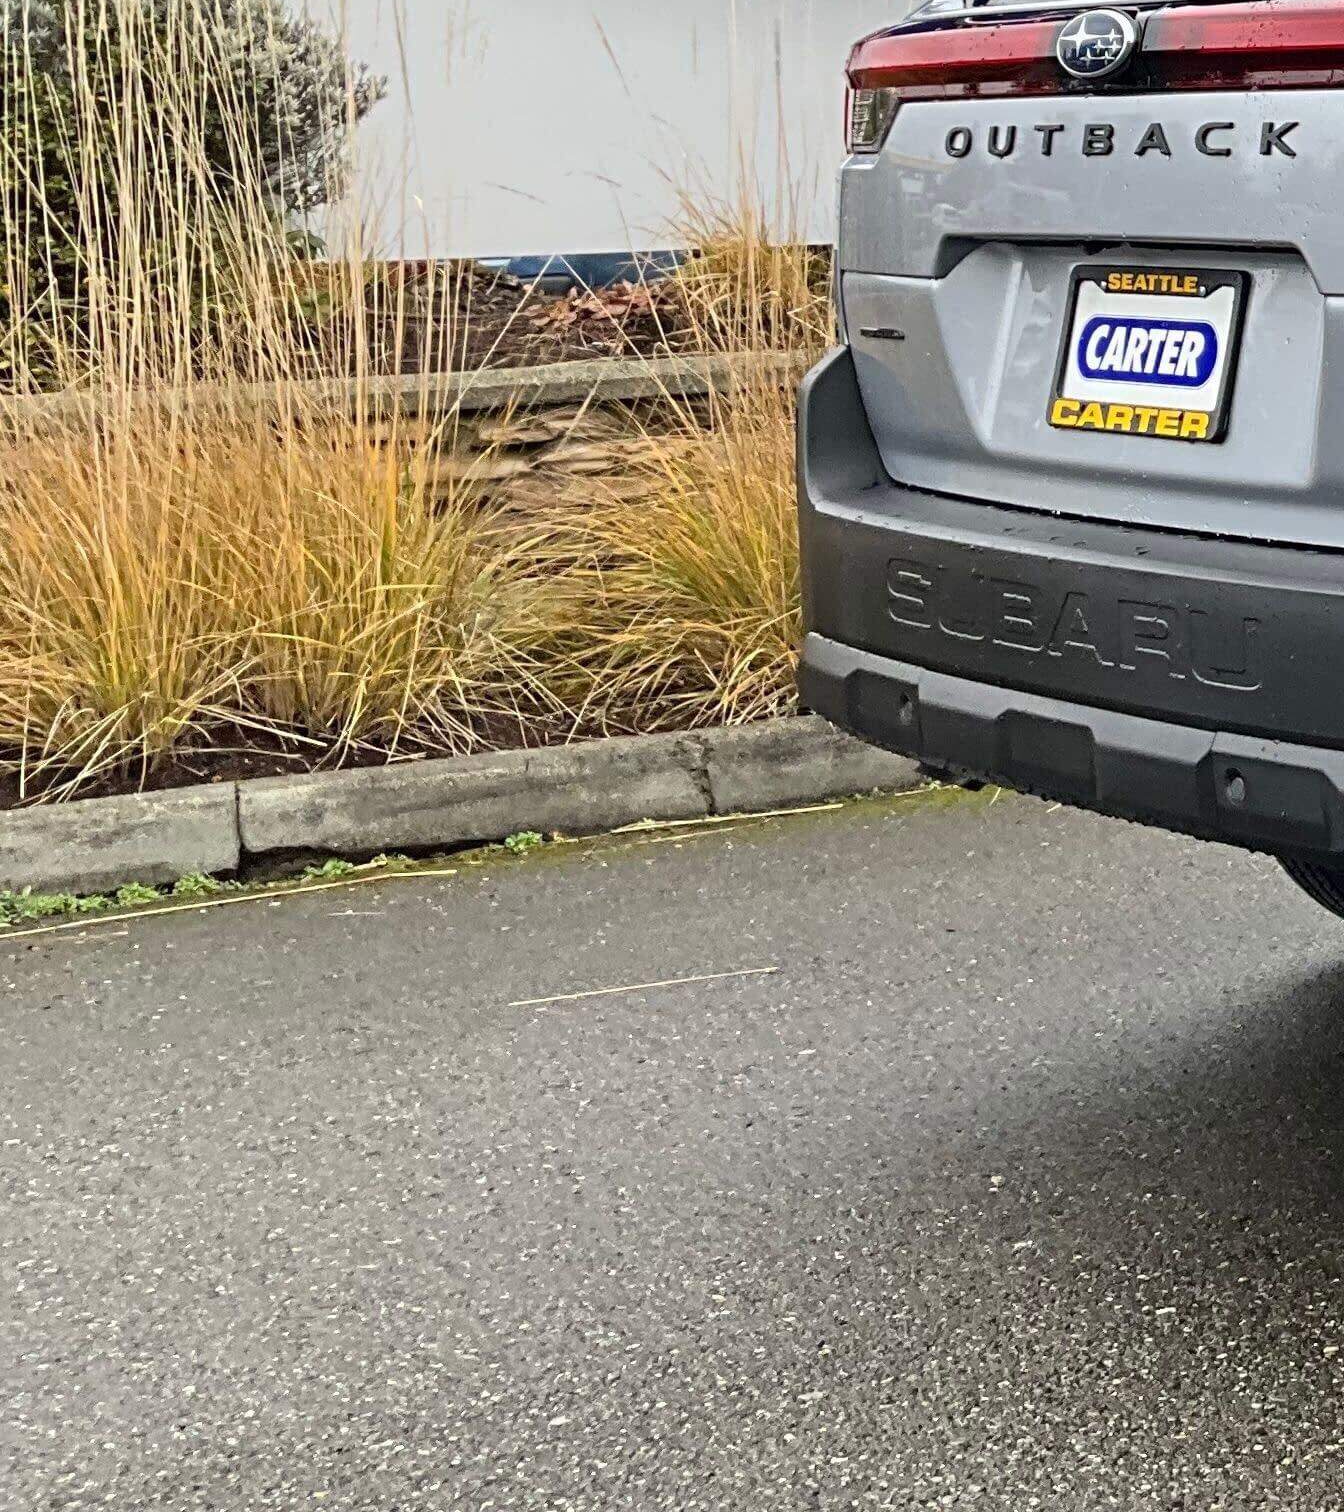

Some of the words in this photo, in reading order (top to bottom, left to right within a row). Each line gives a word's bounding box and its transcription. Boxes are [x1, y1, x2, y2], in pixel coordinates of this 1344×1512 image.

[945, 121, 1300, 159] OUTBACK
[1107, 272, 1199, 293] SEATTLE
[1085, 324, 1205, 378] CARTER
[1051, 398, 1210, 439] CARTER
[887, 557, 1262, 691] SUBARU
